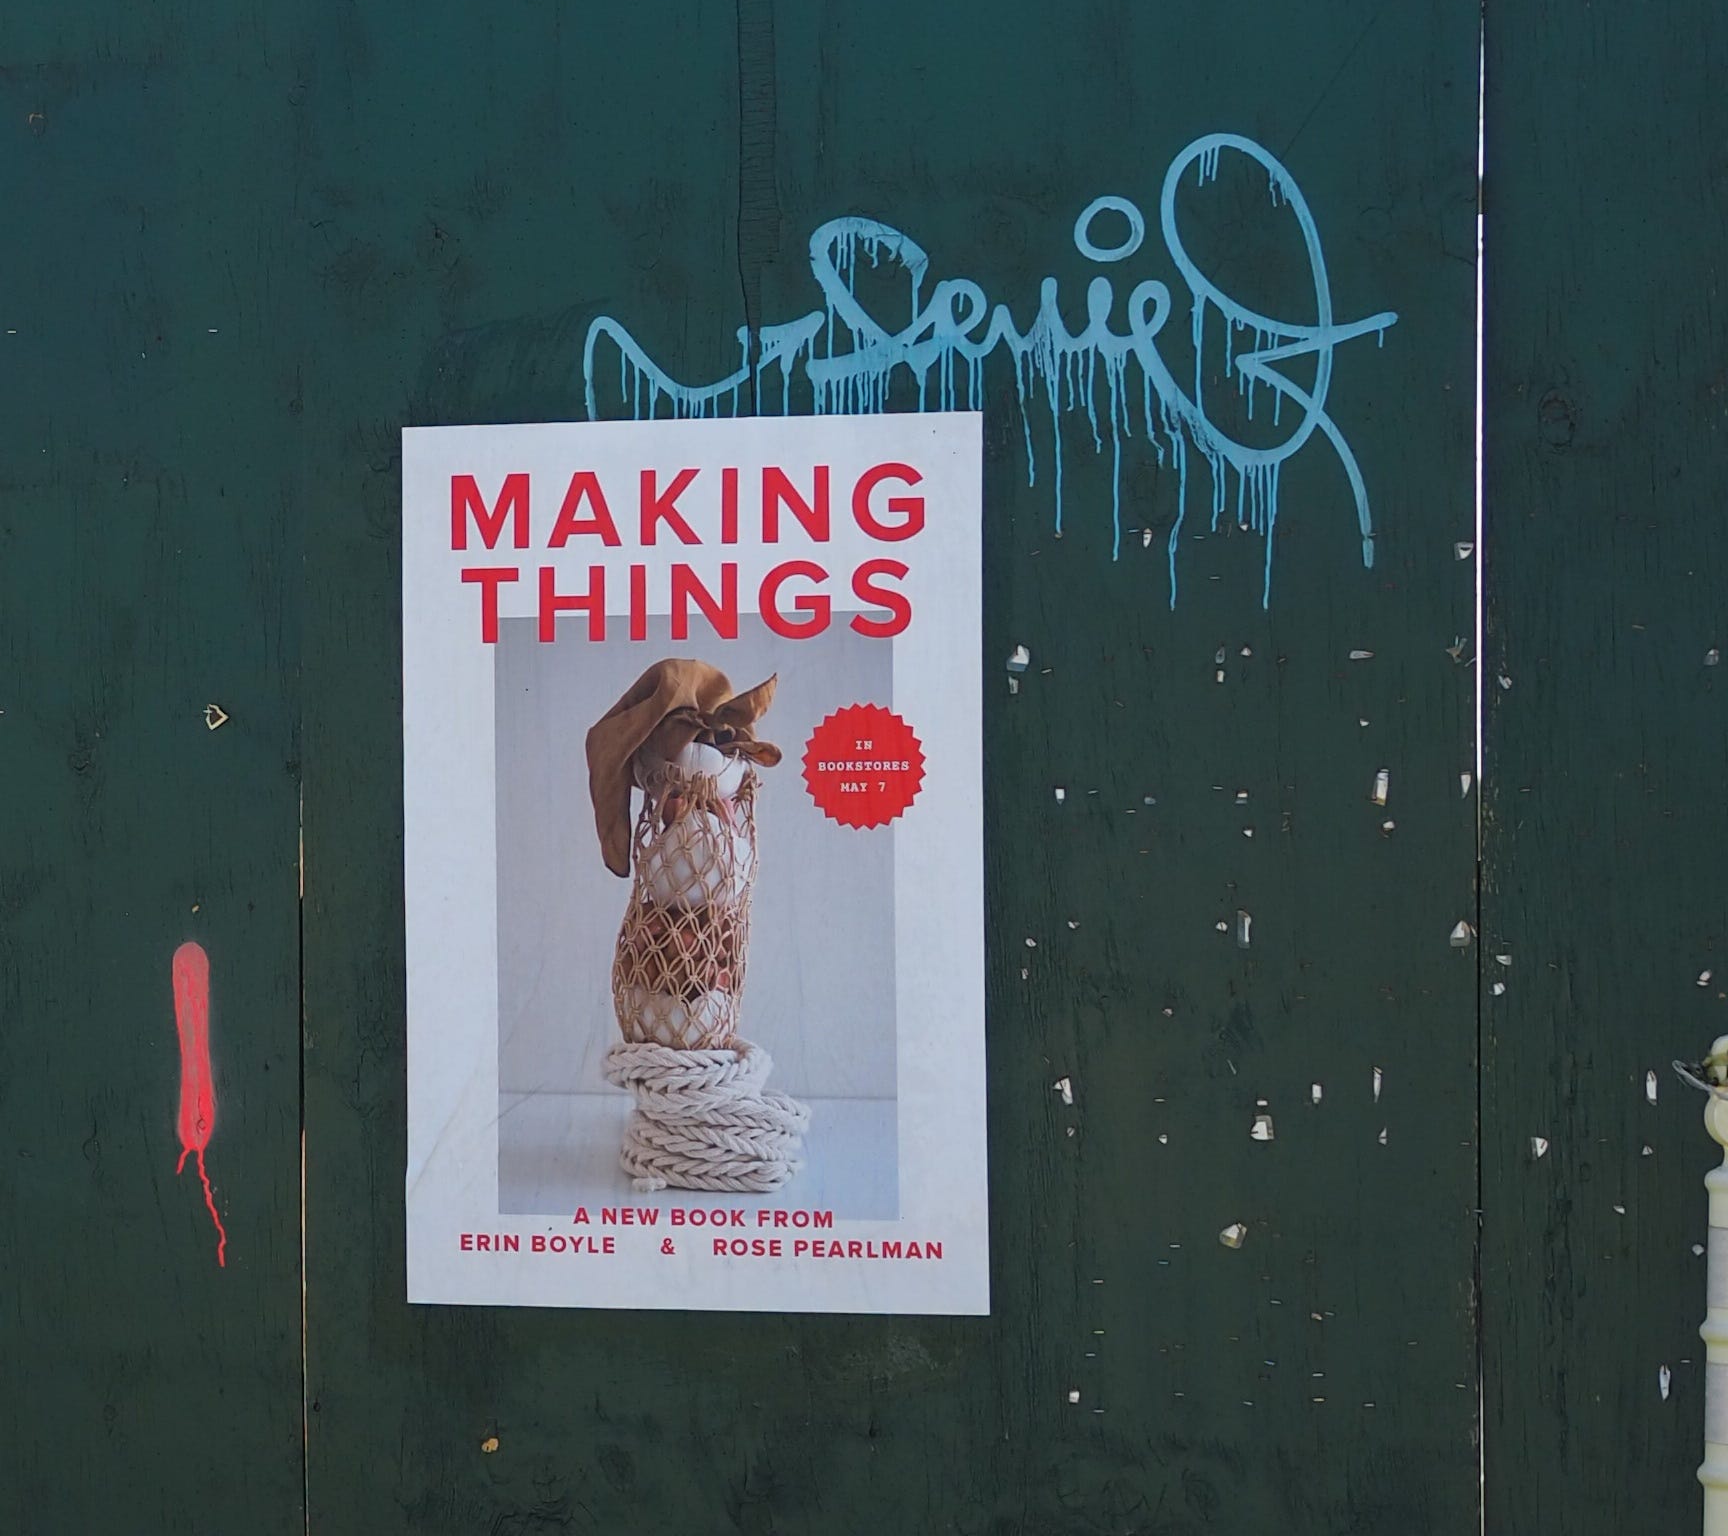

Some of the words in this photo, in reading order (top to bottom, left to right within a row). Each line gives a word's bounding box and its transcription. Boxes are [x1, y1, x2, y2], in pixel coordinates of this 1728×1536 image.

[450, 462, 926, 551] MAKING
[460, 557, 912, 644] THINGS
[856, 741, 873, 750] IN
[818, 761, 910, 771] BOOKSTORES
[840, 783, 867, 792] MAY
[878, 782, 886, 792] 7
[573, 1206, 591, 1225] A
[601, 1207, 660, 1226] NEW
[670, 1207, 746, 1227] BOOK
[757, 1209, 834, 1228] FROM
[459, 1233, 521, 1252] ERIN
[531, 1234, 616, 1254] BOYLE
[660, 1237, 676, 1256] &
[712, 1237, 782, 1257] ROSE
[793, 1239, 944, 1260] PEARLMAN
